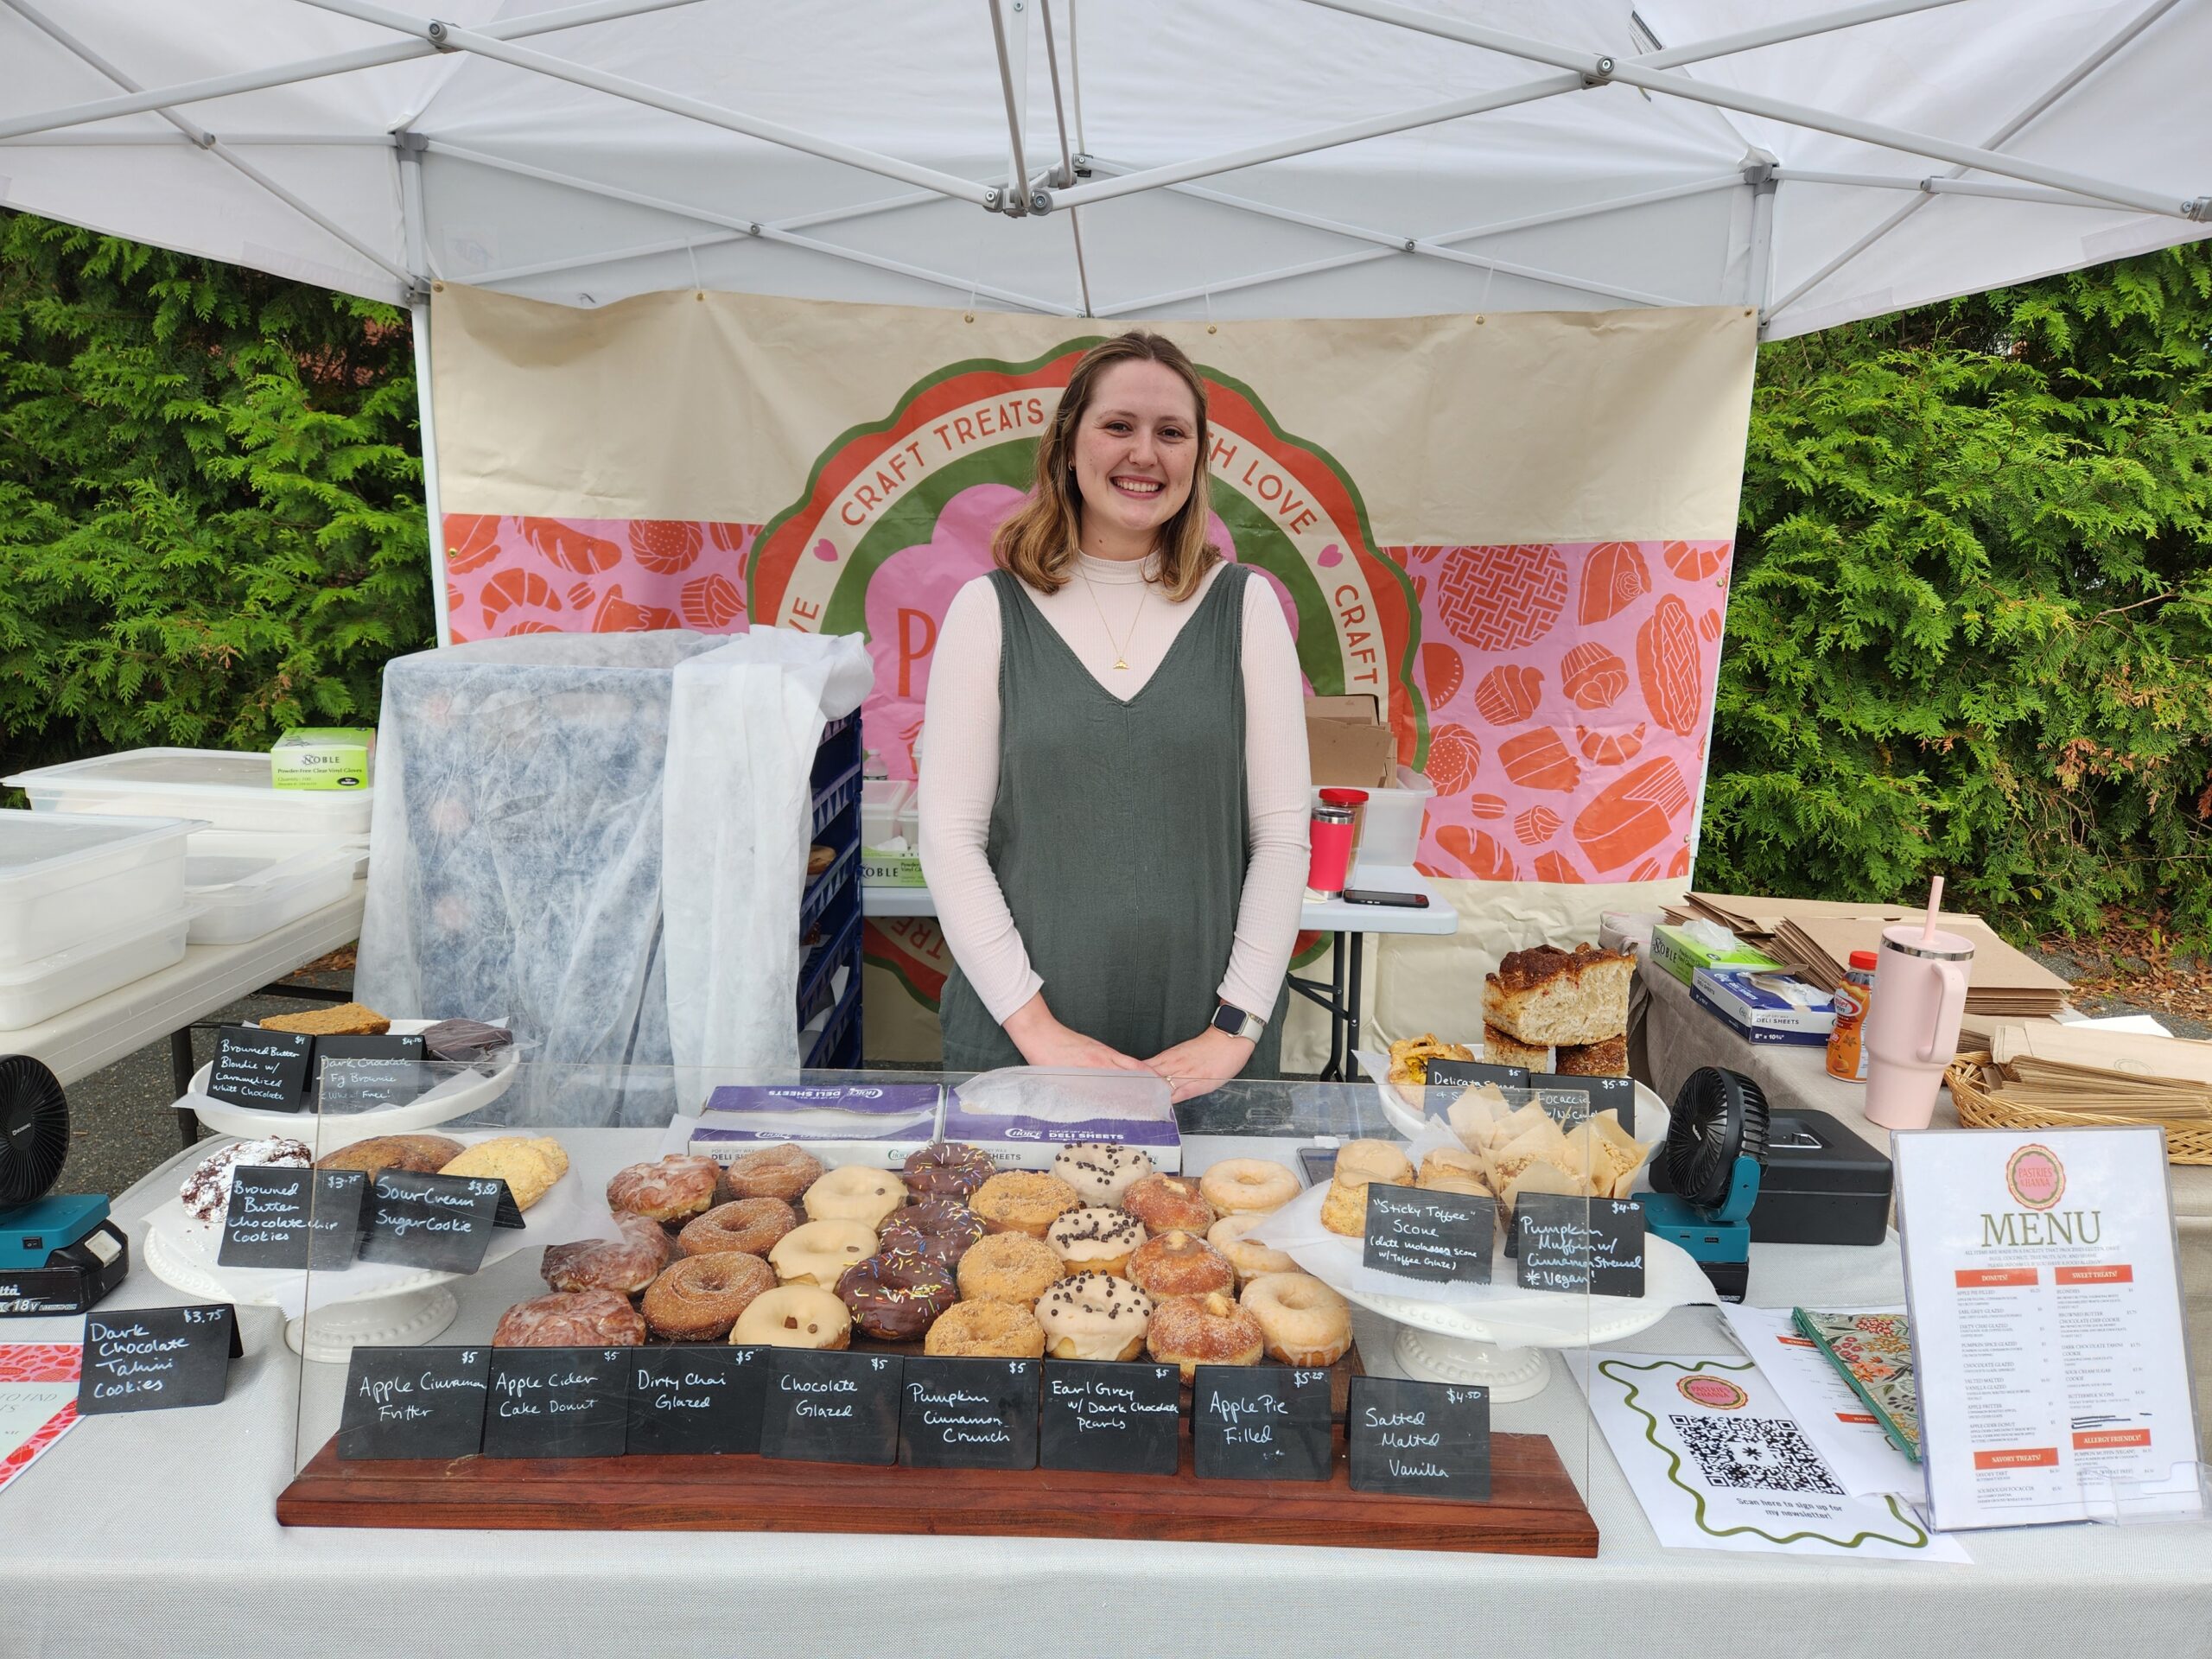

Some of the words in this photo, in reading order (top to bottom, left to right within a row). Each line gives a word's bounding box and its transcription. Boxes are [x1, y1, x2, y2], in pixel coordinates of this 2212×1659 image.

[841, 441, 925, 526] CRAFT
[933, 397, 1045, 451] TREATS
[1242, 460, 1319, 535] LOVE
[1335, 584, 1377, 684] CRAFT
[302, 753, 340, 765] NOBLE
[862, 867, 898, 878] OBLE
[295, 1035, 305, 1045] $4
[220, 1056, 258, 1071] Blondie
[265, 1063, 280, 1074] w/
[320, 1055, 356, 1070] Dark
[330, 1073, 345, 1088] Fig
[350, 1073, 397, 1083] Brownie
[2018, 1167, 2052, 1178] PASTRIES
[233, 1180, 299, 1195] Browned
[376, 1176, 423, 1201] Sour
[424, 1187, 474, 1207] Cream
[245, 1197, 300, 1213] Butter
[376, 1209, 426, 1236] Sugar
[426, 1217, 473, 1233] Cookie
[1393, 1219, 1440, 1237] Scone
[1520, 1216, 1604, 1238] Pumpkin
[1980, 1211, 2101, 1247] MENU
[232, 1230, 289, 1243] Cookies
[1538, 1235, 1597, 1256] Muffin
[1598, 1237, 1618, 1254] w/
[183, 1308, 226, 1324] $3.75
[90, 1323, 149, 1342] Dark
[99, 1338, 190, 1357] Chocolate
[461, 1351, 478, 1364] $5
[604, 1351, 620, 1362] $5
[871, 1357, 888, 1371] $5
[95, 1357, 174, 1376] Tahini
[1009, 1363, 1027, 1374] $5
[1155, 1368, 1169, 1379] $5
[93, 1380, 163, 1398] Cookies
[495, 1372, 543, 1398] Apple
[548, 1374, 598, 1388] Cider
[638, 1370, 679, 1391] Dirty
[685, 1372, 726, 1386] Chai
[780, 1375, 858, 1392] Chocolate
[359, 1376, 413, 1403] Apple
[907, 1383, 988, 1408] Pumpkin
[1052, 1381, 1090, 1395] Earl
[1096, 1382, 1134, 1401] Grey
[1446, 1388, 1481, 1403] $4.50
[499, 1401, 541, 1417] Cake
[550, 1399, 599, 1414] Donut
[655, 1394, 711, 1411] Glazed
[796, 1400, 854, 1417] Glazed
[1068, 1399, 1083, 1414] w/
[1088, 1402, 1127, 1414] Dark
[1210, 1391, 1258, 1423] Apple
[1257, 1394, 1288, 1414] Pie
[378, 1405, 435, 1421] Fritter
[923, 1411, 1002, 1426] Cinnamon
[1365, 1408, 1426, 1427] Salted
[943, 1428, 1010, 1443] Crunch
[1224, 1426, 1273, 1445] Filled
[1382, 1433, 1440, 1448] Malted
[1389, 1459, 1450, 1478] Vanilla
[1781, 1510, 1833, 1520] newsletter!
